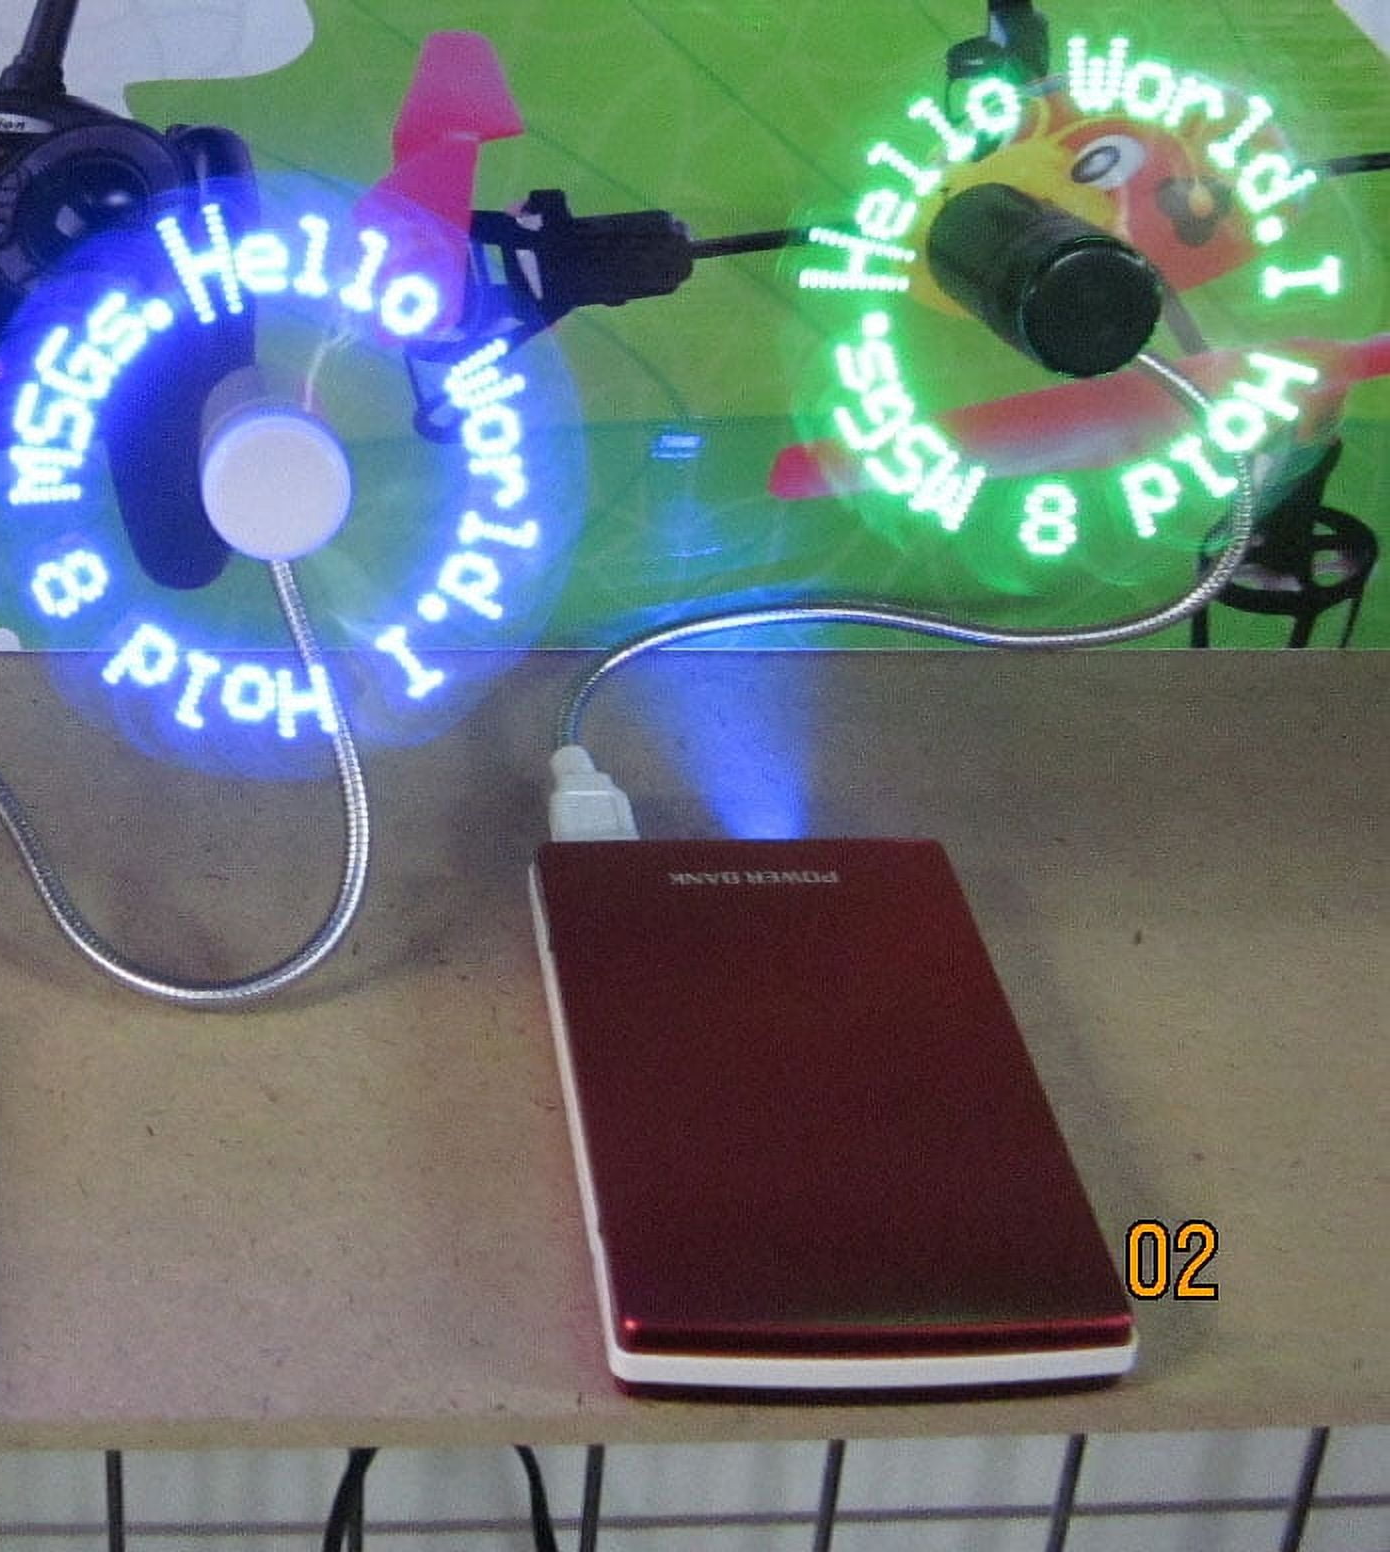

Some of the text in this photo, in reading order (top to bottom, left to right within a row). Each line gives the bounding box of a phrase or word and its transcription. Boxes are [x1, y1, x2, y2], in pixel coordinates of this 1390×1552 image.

[798, 76, 1022, 293] Hello
[155, 203, 440, 336] Hello
[8, 290, 175, 506] MSGs.
[833, 310, 986, 533] MSGs.
[1121, 350, 1319, 539] Hold
[30, 549, 109, 619] 8
[1018, 482, 1079, 556] 8
[101, 622, 339, 740] Hold
[667, 870, 840, 886] POWER BANK
